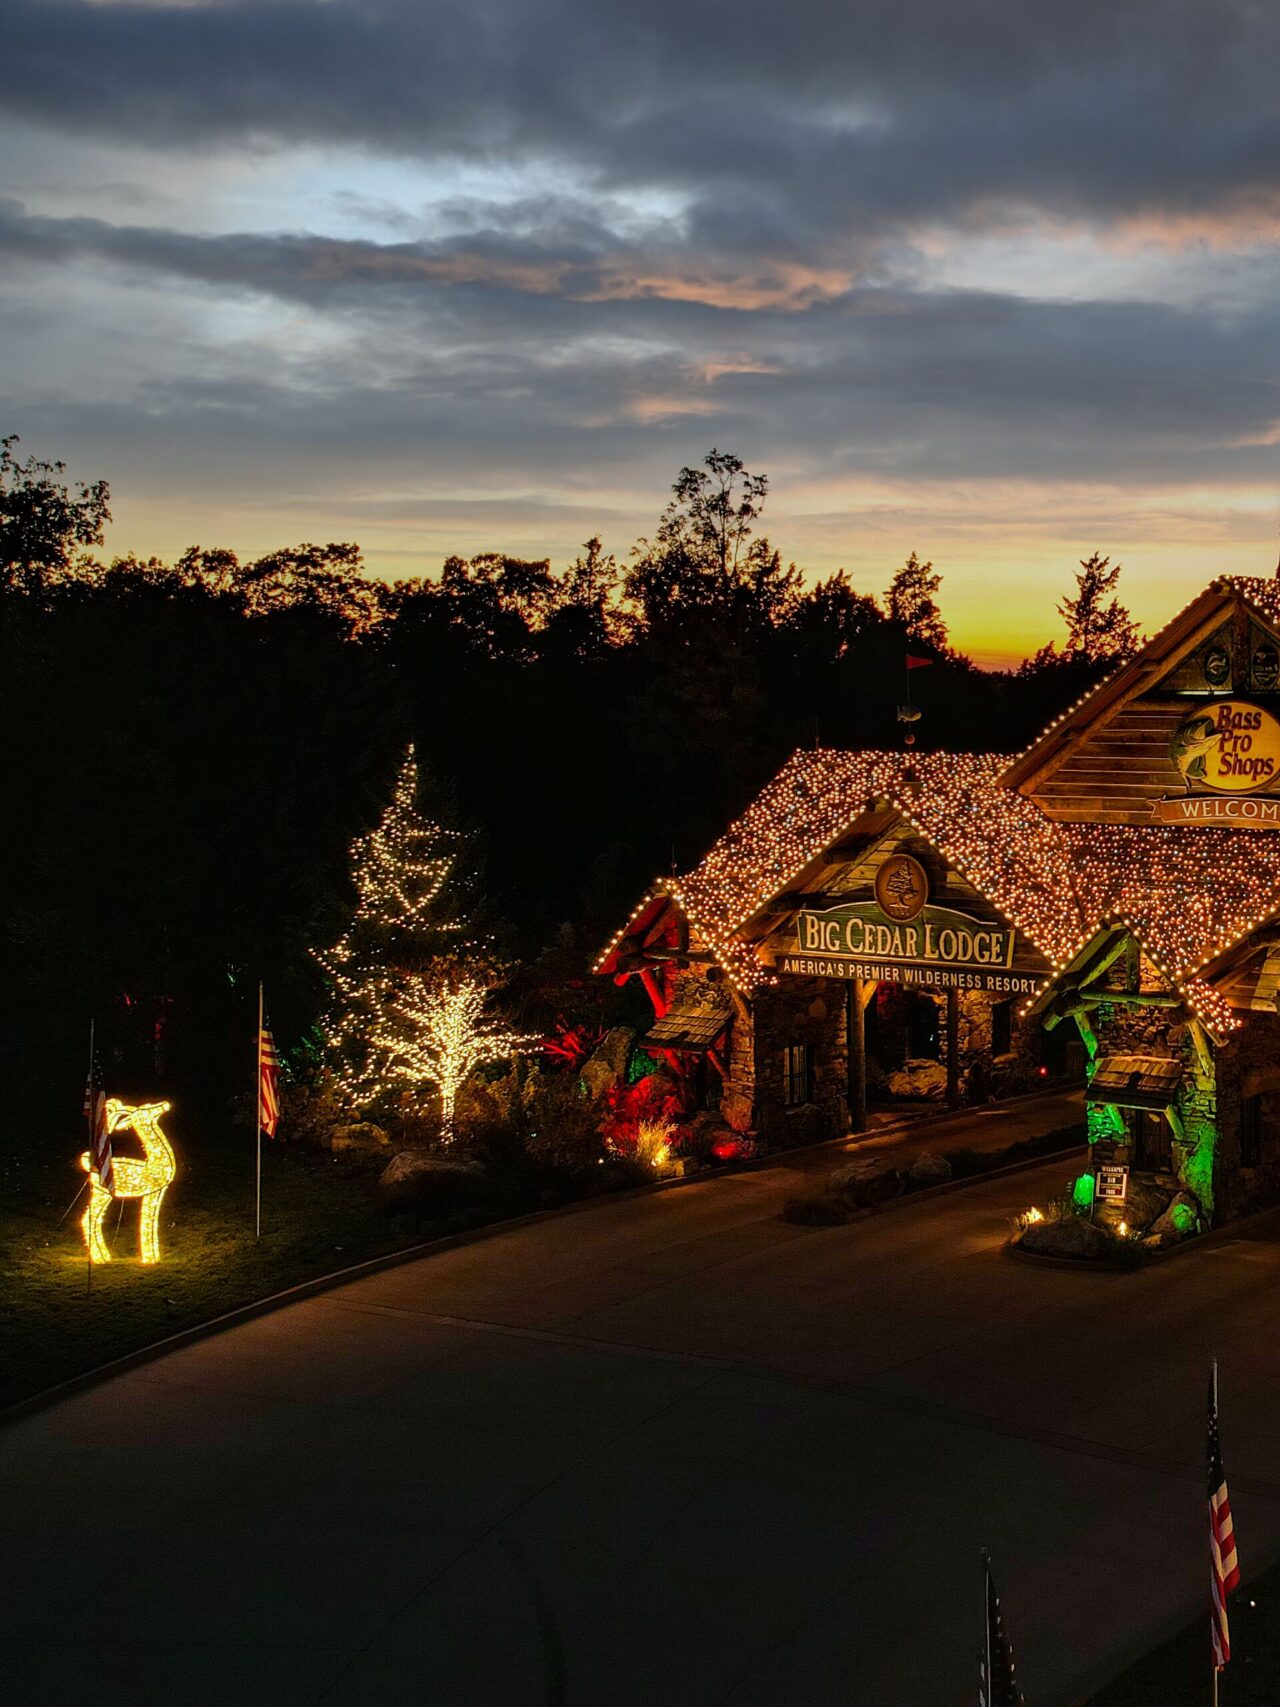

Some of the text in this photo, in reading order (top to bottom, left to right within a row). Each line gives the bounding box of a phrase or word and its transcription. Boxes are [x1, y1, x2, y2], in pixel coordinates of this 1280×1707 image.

[1215, 705, 1262, 731] Bass
[1218, 729, 1253, 753] Pro
[1217, 752, 1275, 782] Shops
[783, 958, 1037, 994] AMERICA'S PREMIER WILDERNESS RESORT
